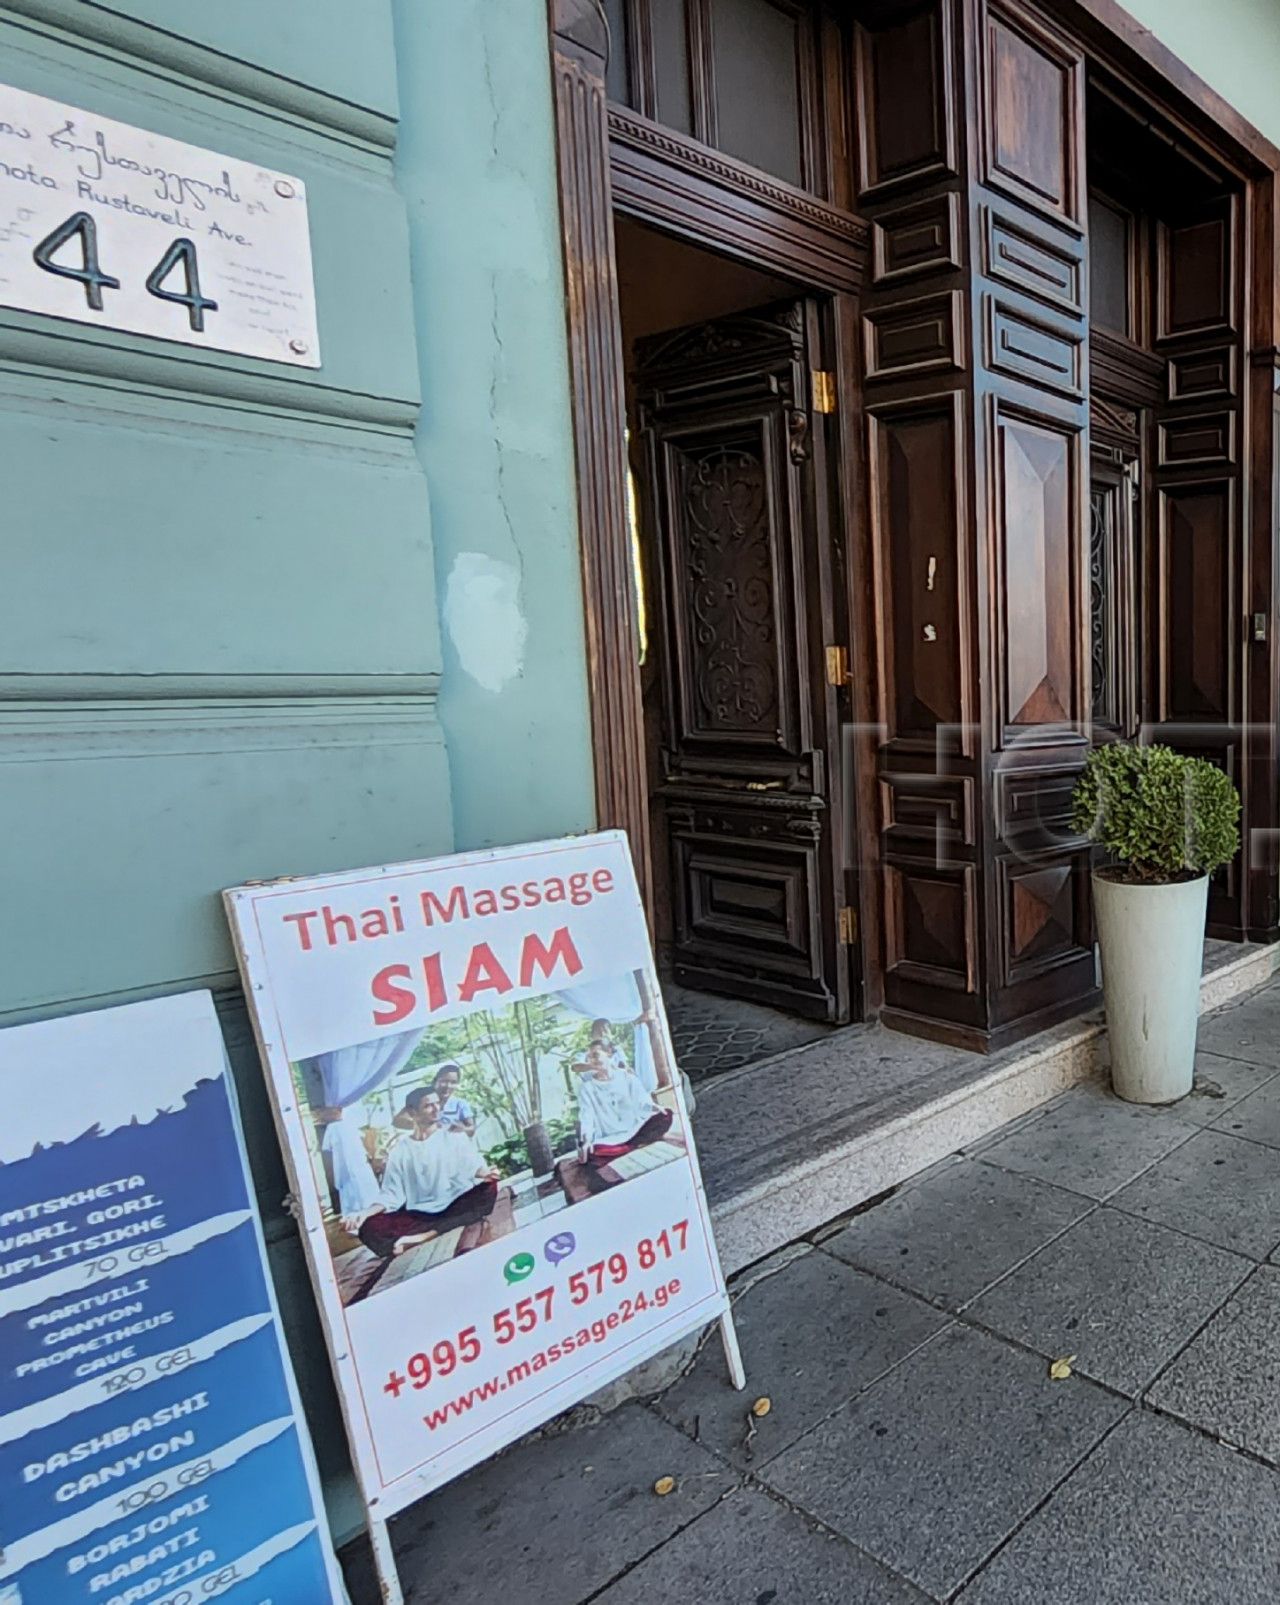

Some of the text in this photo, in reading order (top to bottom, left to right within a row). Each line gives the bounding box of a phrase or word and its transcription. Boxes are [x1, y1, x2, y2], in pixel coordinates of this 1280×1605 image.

[76, 180, 195, 230] Rustaveli
[208, 221, 252, 246] Ave.
[33, 211, 218, 333] 44
[283, 868, 614, 951] Thai Massage
[371, 926, 583, 1026] SIAM
[0, 1175, 146, 1228] MTSKHETA
[84, 1241, 168, 1280] 70 GEL
[27, 1278, 150, 1330] MARTVILI
[43, 1301, 143, 1346] CANYON
[383, 1219, 690, 1398] +995 557 579 817
[15, 1310, 174, 1378] PROMETHEUS
[75, 1345, 137, 1378] CAVE
[101, 1348, 197, 1395] 120 GEL
[423, 1278, 682, 1431] www.massage24.ge
[22, 1391, 210, 1484] DASHBASHI
[55, 1430, 195, 1502] CANYON
[115, 1459, 218, 1514] 100 GEL
[67, 1494, 210, 1575] BORJOMI
[89, 1527, 201, 1593] RABATI
[201, 1565, 242, 1595] GEL
